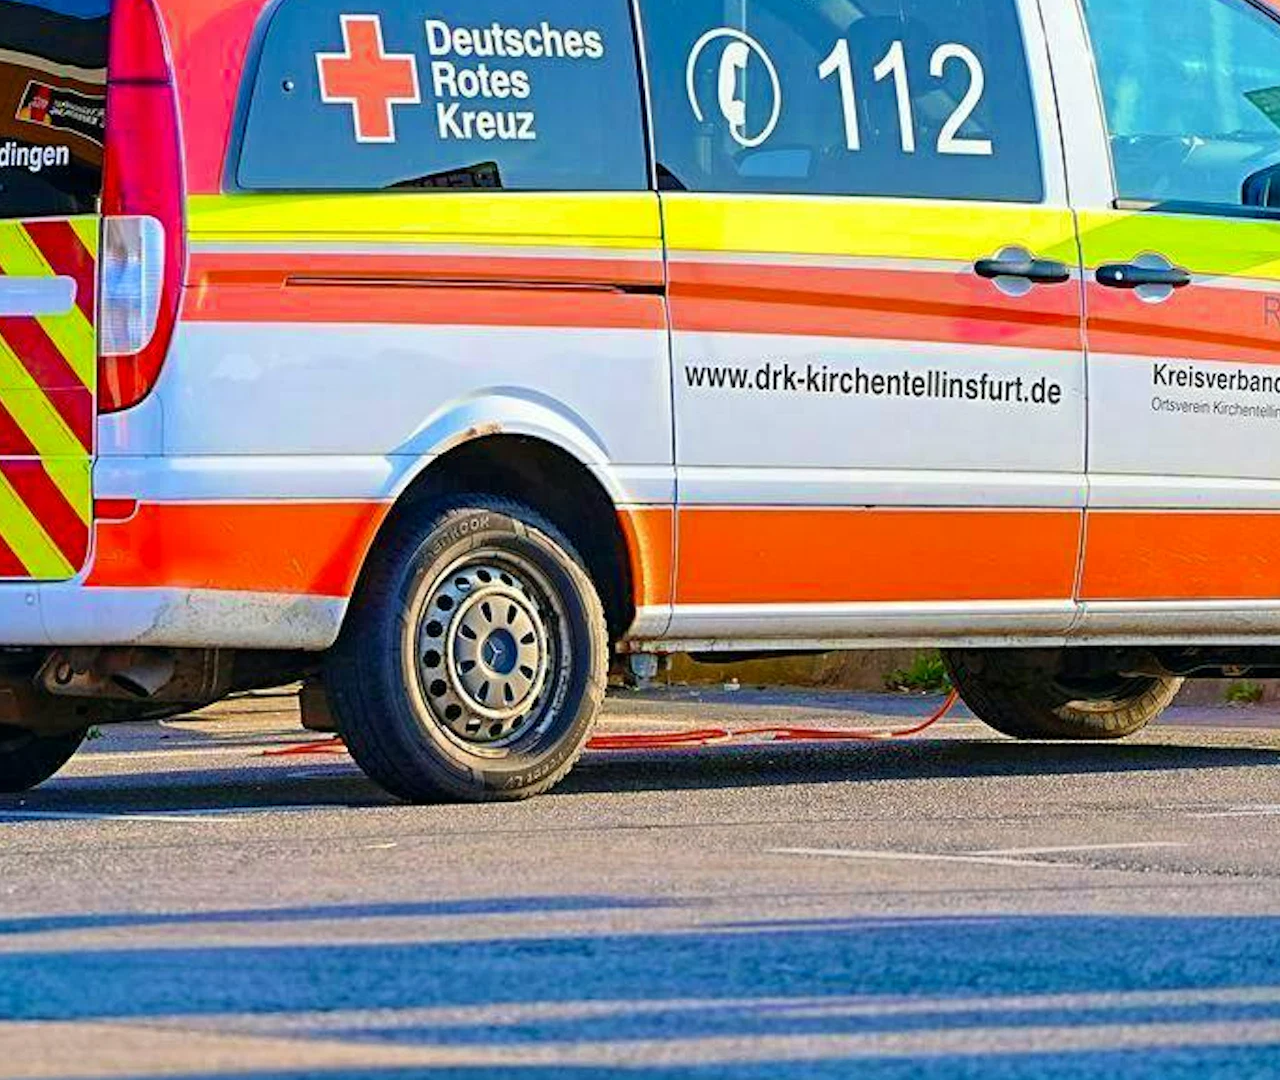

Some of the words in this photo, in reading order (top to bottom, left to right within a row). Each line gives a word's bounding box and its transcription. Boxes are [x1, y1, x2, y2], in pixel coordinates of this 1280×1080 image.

[425, 19, 604, 60] Deutsches
[431, 61, 531, 99] Rotes
[818, 38, 993, 155] 112
[436, 102, 537, 140] Kreuz
[685, 363, 1062, 405] www.drk-kirchentellinsfurt.de
[1151, 396, 1210, 414] Ortsverein
